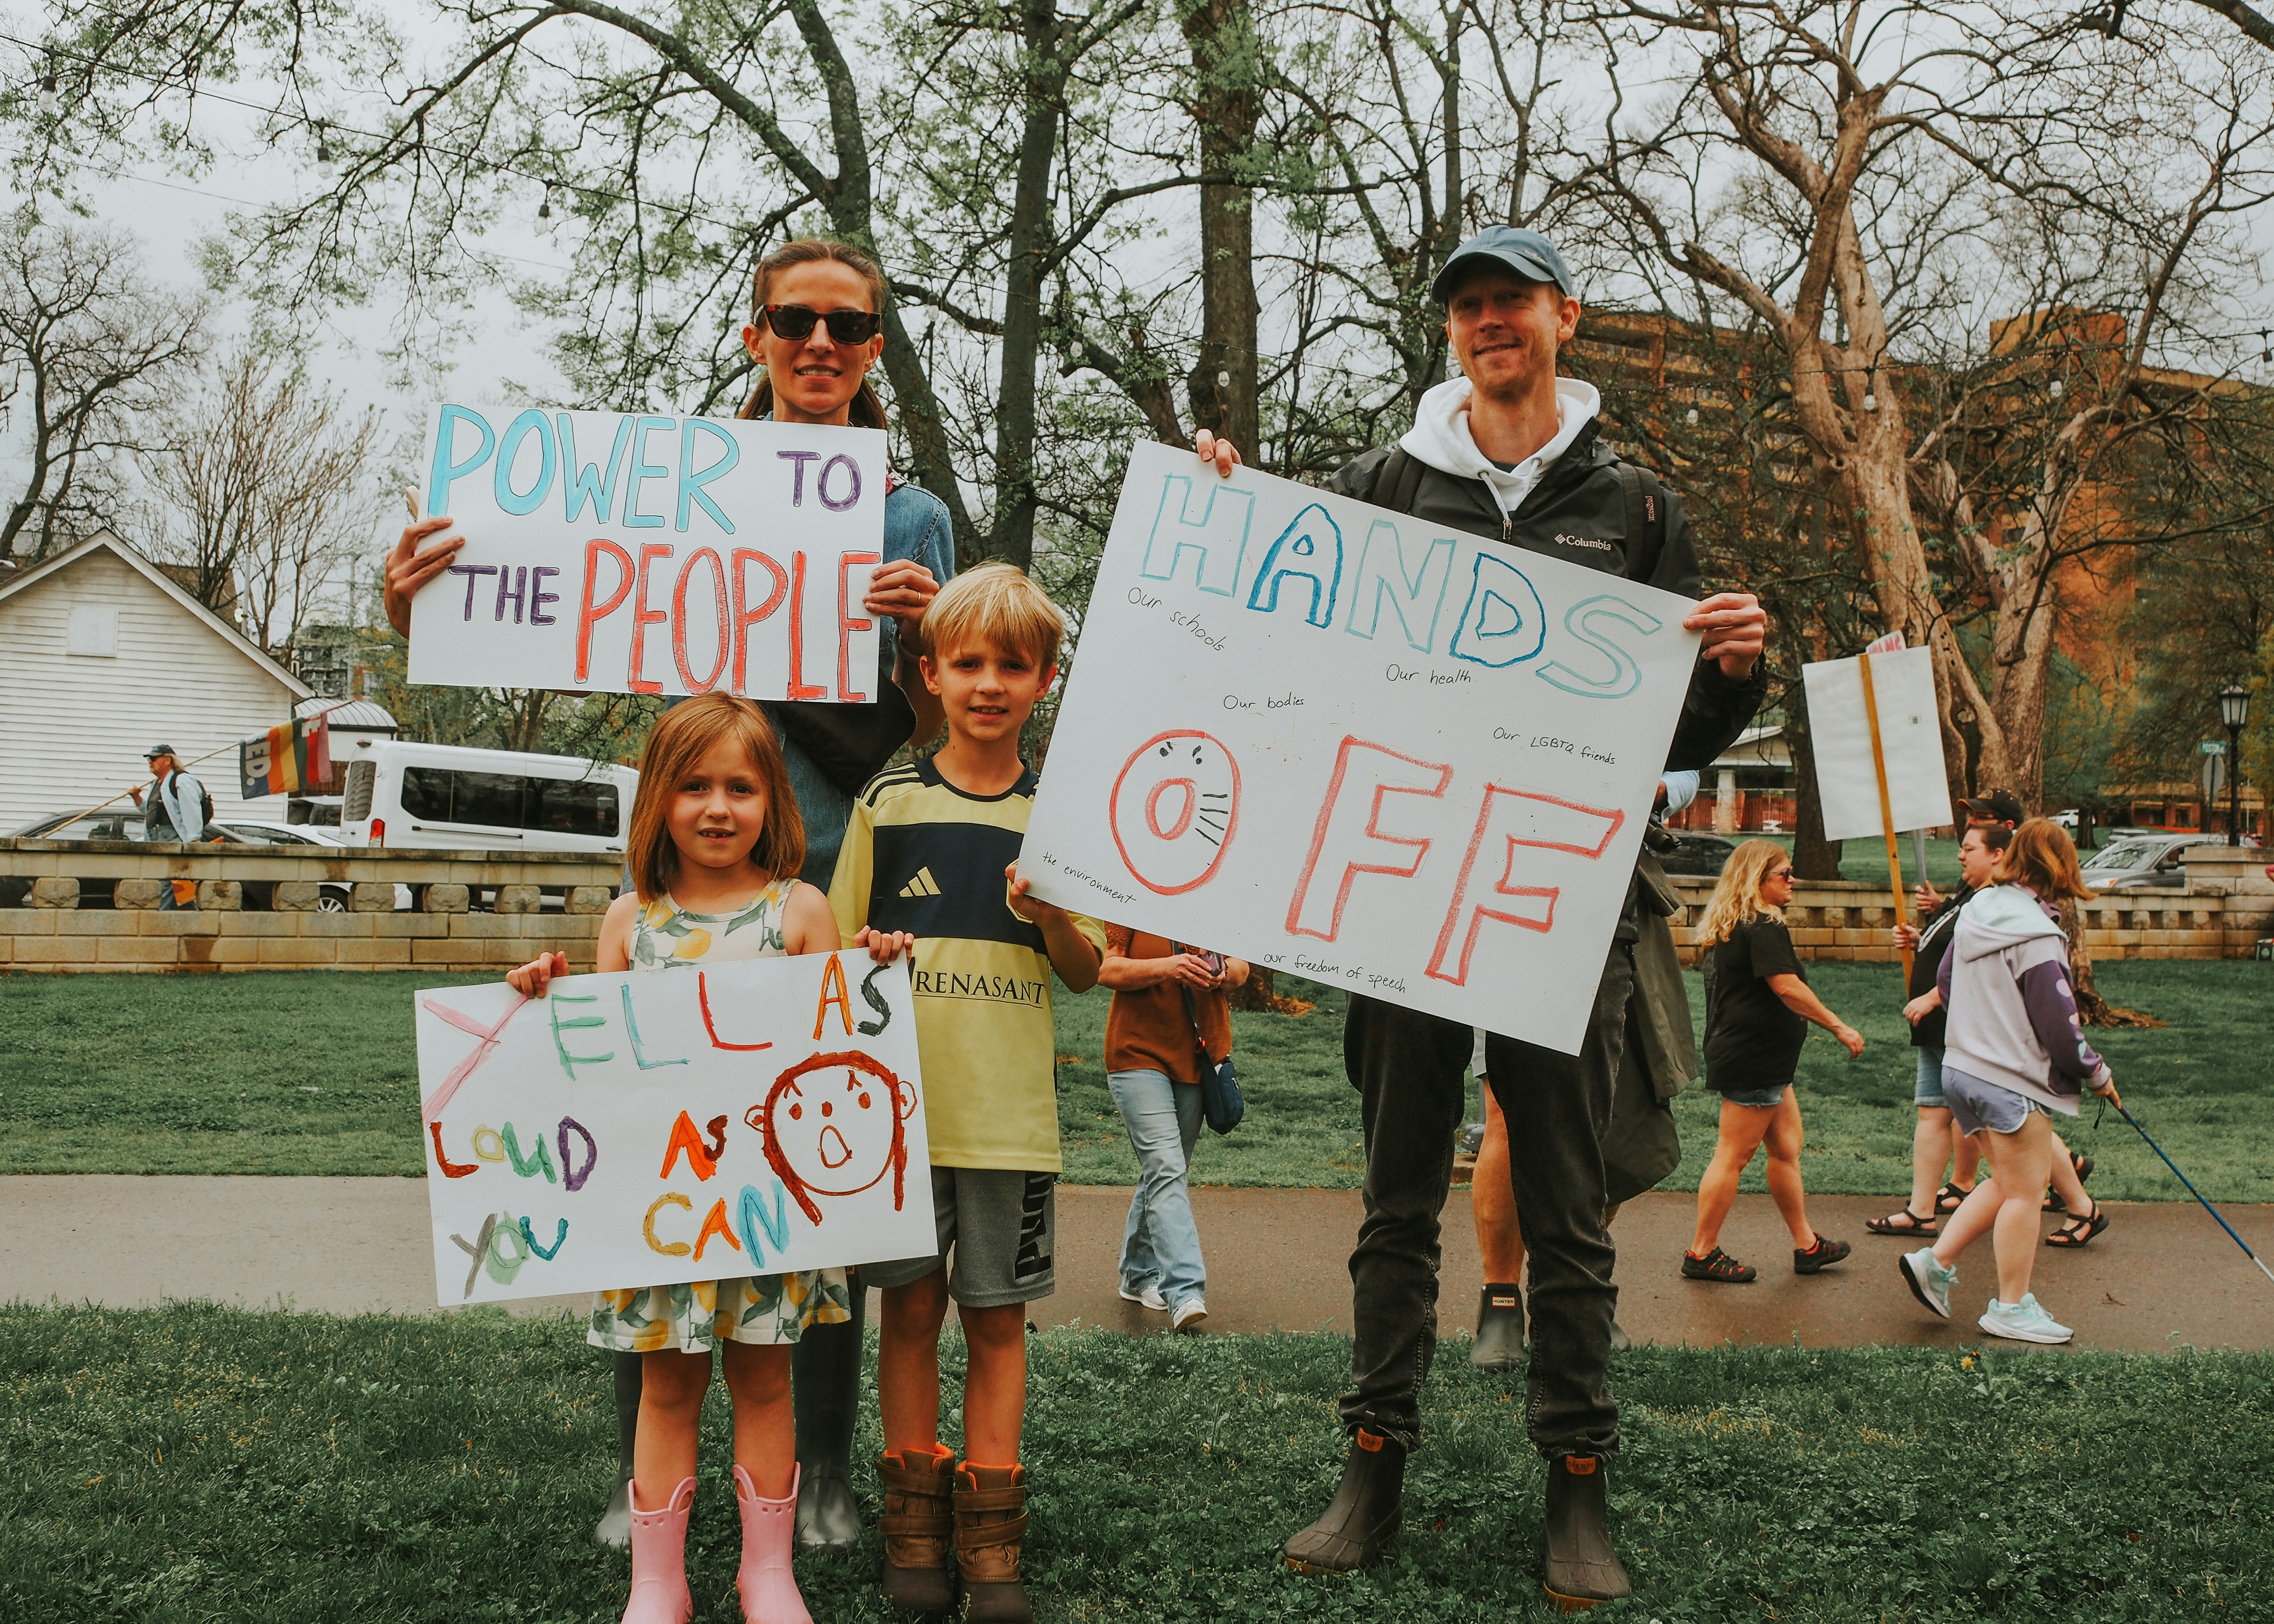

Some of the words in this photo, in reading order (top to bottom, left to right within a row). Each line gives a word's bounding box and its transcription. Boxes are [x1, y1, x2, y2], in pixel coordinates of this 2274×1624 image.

[428, 403, 739, 534] POWER
[776, 450, 861, 512] TO
[1566, 535, 1611, 551] Columbia
[1139, 474, 1663, 699] HANDS
[448, 565, 559, 626] THE
[574, 539, 881, 702] PEOPLE
[1128, 587, 1162, 609] Our
[1169, 611, 1227, 651] schools
[1223, 695, 1256, 710] Our
[1268, 691, 1304, 709] bodies
[1386, 664, 1419, 681] Our
[1430, 669, 1471, 686] health
[1493, 727, 1520, 740] Our
[1530, 736, 1574, 754] LGBTQ
[1580, 746, 1615, 764] friends
[1043, 851, 1057, 865] the
[1064, 866, 1137, 904] environment
[1109, 729, 1625, 986] OFF
[914, 970, 1045, 1004] RENASANT
[1264, 953, 1287, 963] our
[1294, 954, 1339, 975] freedom
[1346, 967, 1364, 979] of
[1367, 973, 1405, 993] speech
[421, 972, 773, 1127] YELL
[813, 951, 892, 1040] AS
[430, 1116, 597, 1192] LOUD
[659, 1109, 728, 1182] AS
[449, 1211, 569, 1299] YOU
[642, 1179, 790, 1269] CAN
